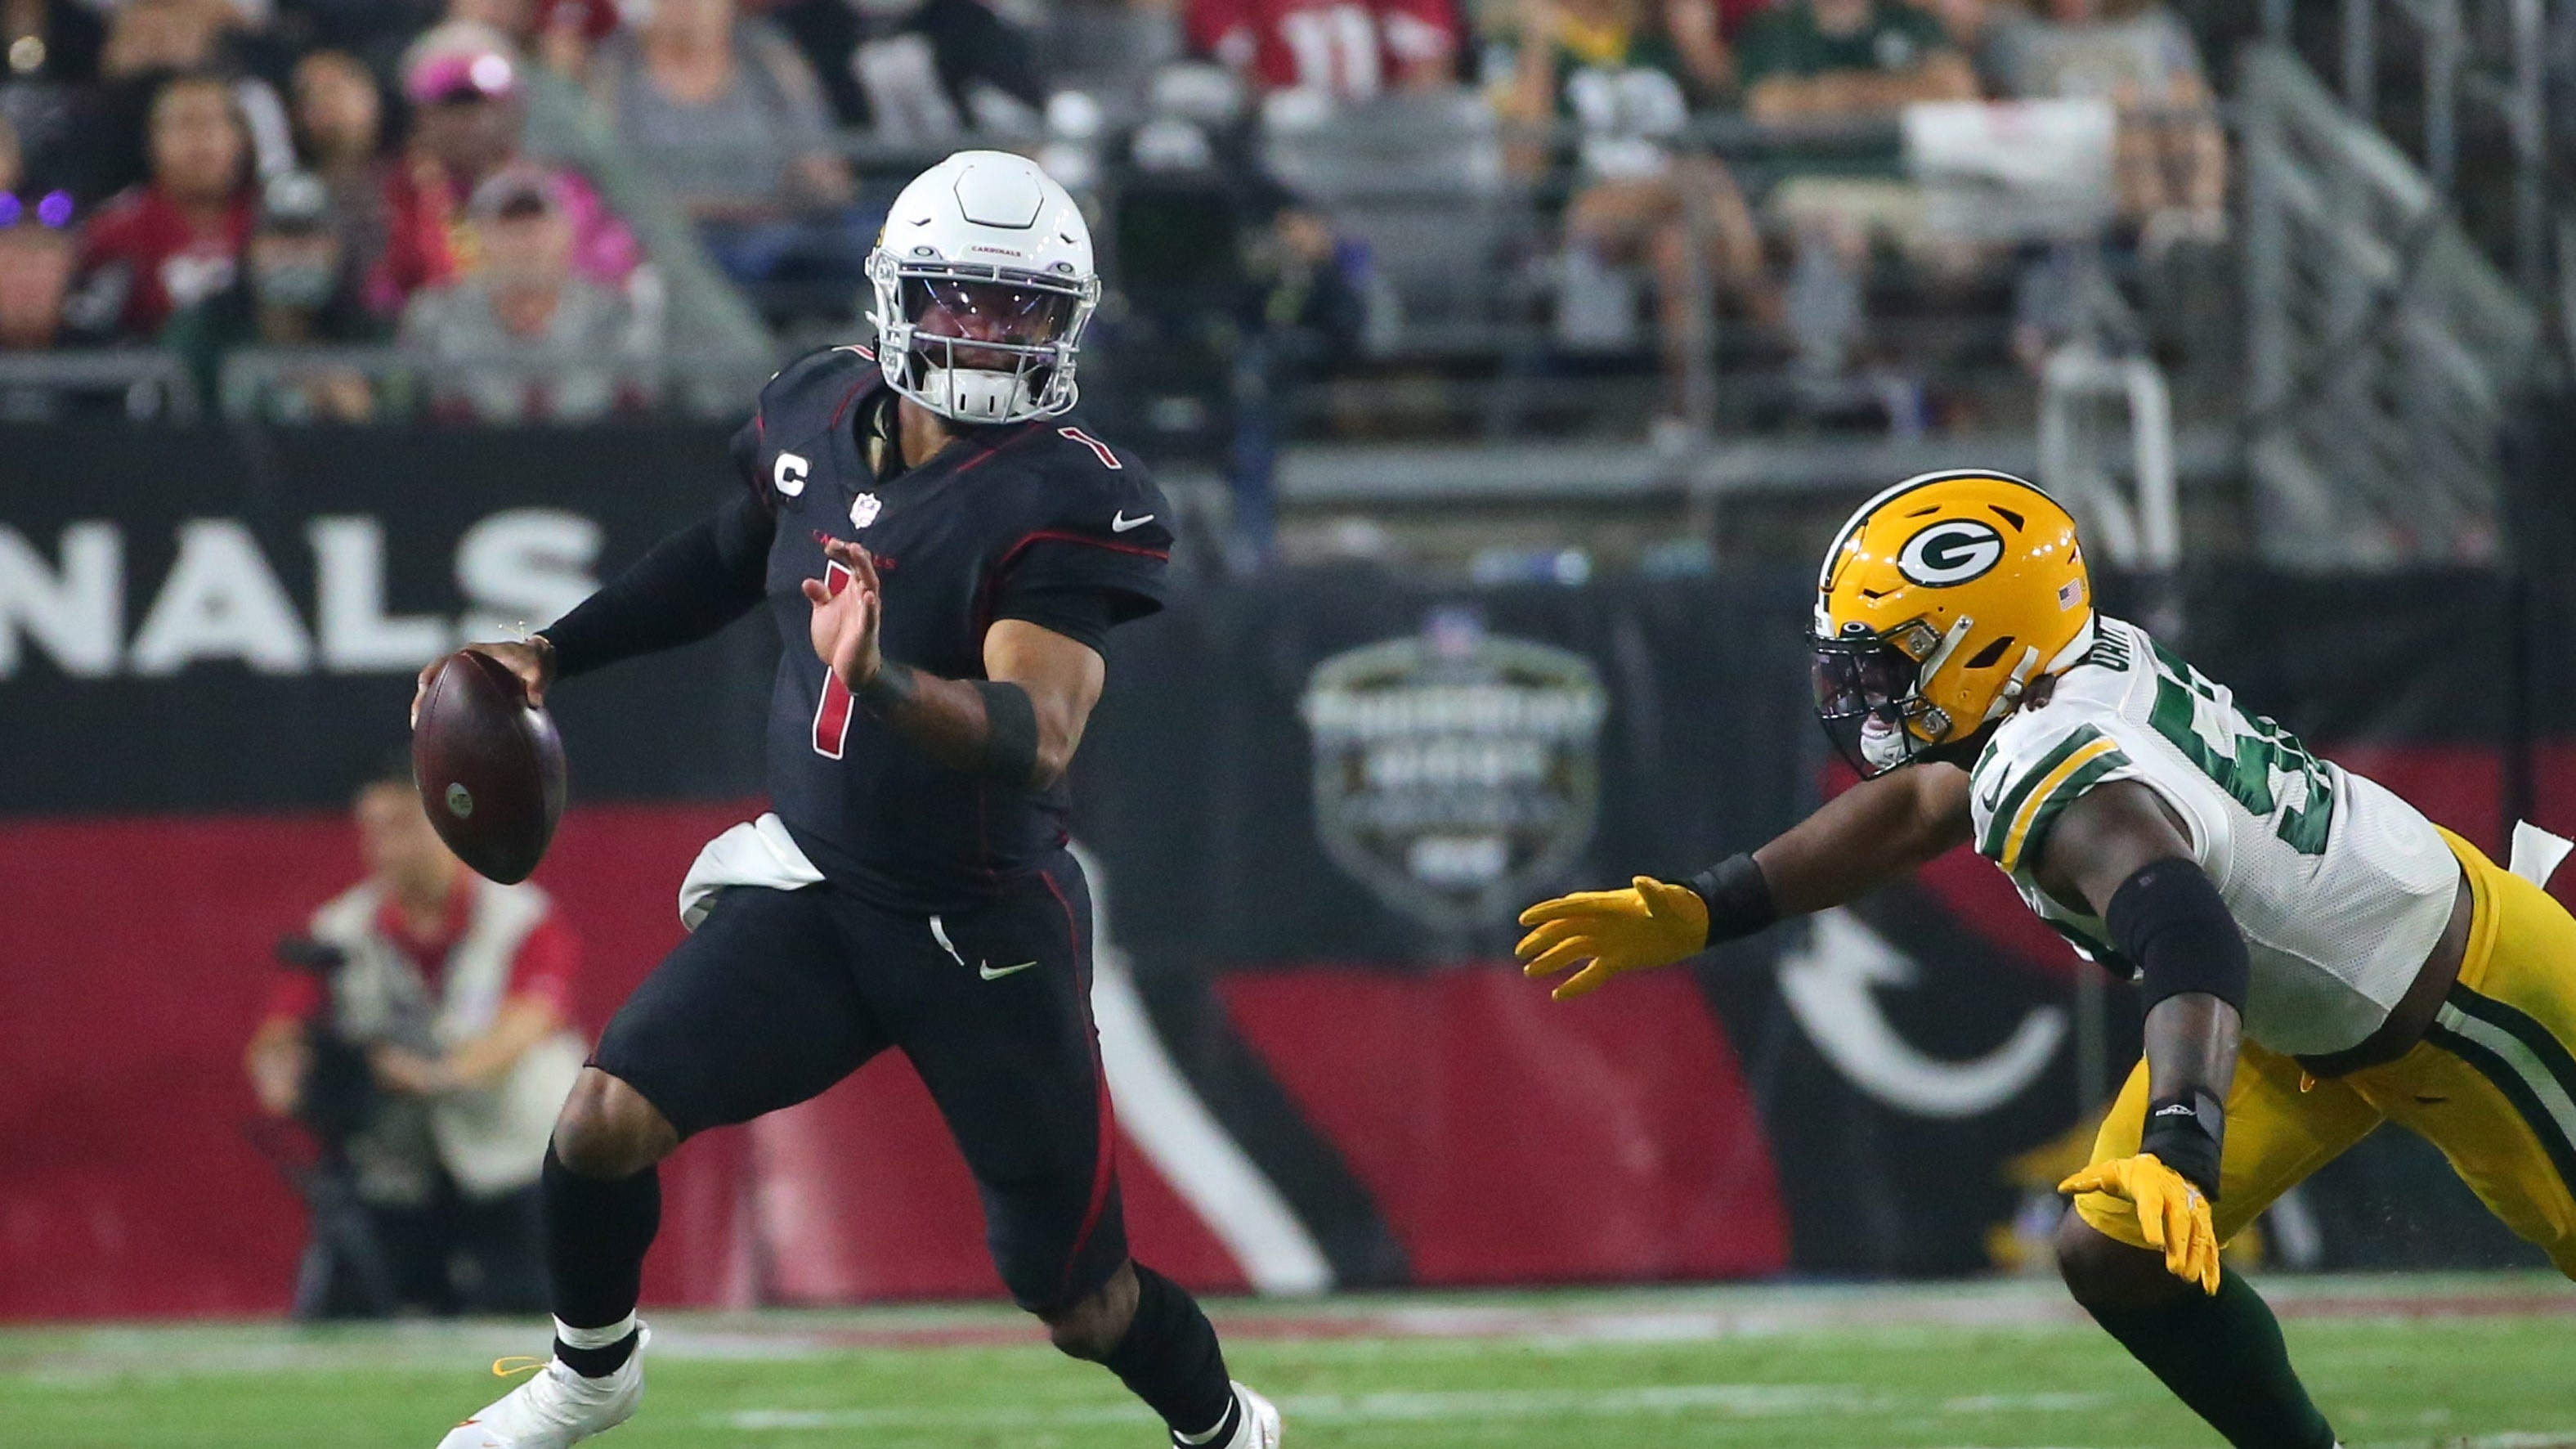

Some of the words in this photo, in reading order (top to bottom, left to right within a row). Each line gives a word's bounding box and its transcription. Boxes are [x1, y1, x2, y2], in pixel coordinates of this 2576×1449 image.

[971, 245, 1021, 258] CARDINALS
[774, 453, 809, 497] C
[1900, 521, 2001, 584] G
